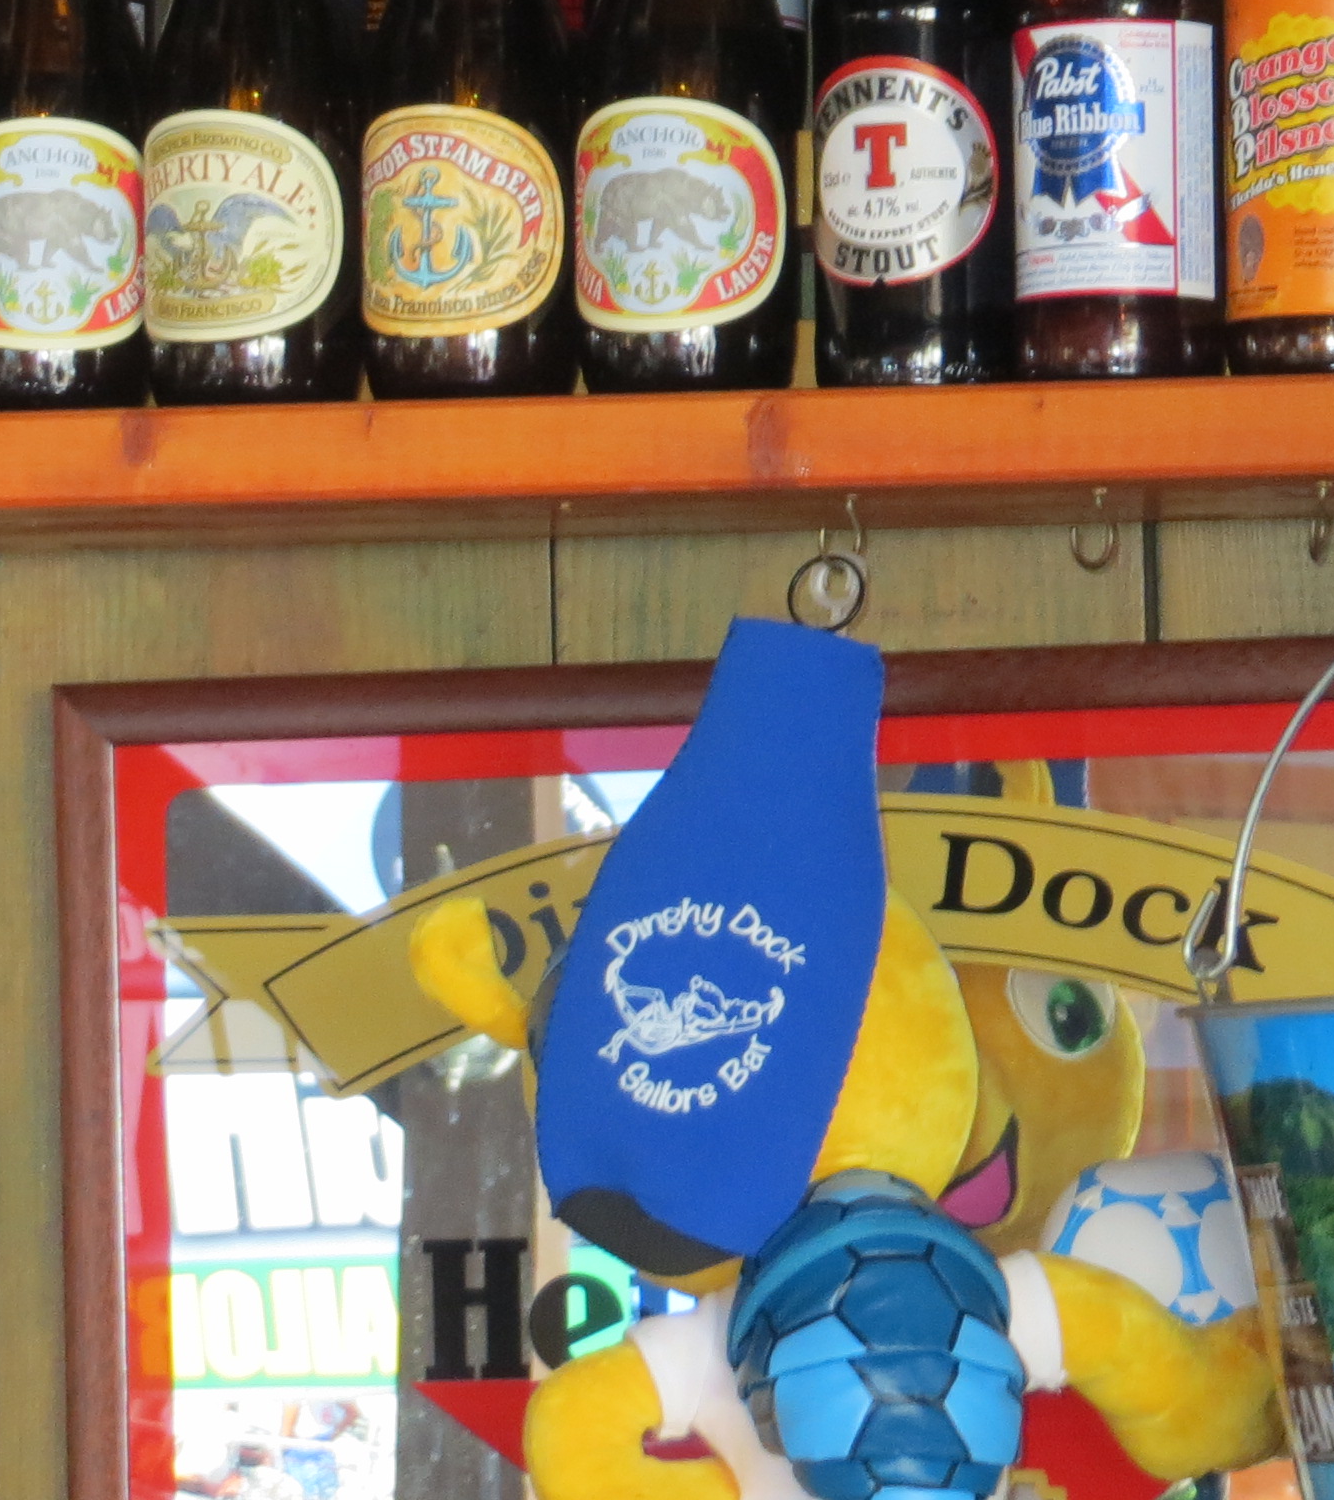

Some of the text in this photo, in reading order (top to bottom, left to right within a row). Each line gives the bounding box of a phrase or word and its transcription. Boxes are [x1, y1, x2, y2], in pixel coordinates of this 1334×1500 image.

[819, 75, 969, 132] ENNENT'S
[1035, 55, 1103, 100] Pabst
[616, 125, 702, 147] ANCHOR
[1020, 101, 1141, 140] Blue Ribbon
[5, 147, 94, 169] ANCHOR
[145, 152, 318, 215] BERTY ALE
[367, 132, 543, 223] CHOR STEAM BEER
[853, 122, 908, 191] T
[833, 234, 942, 275] STOUT
[868, 224, 914, 240] EXPORT
[103, 257, 144, 323] LAG
[713, 230, 775, 301] LAGER
[931, 832, 1279, 973] Dock
[605, 896, 725, 957] Dinghy
[728, 903, 807, 975] Dock
[619, 1032, 773, 1114] Sailors Bar
